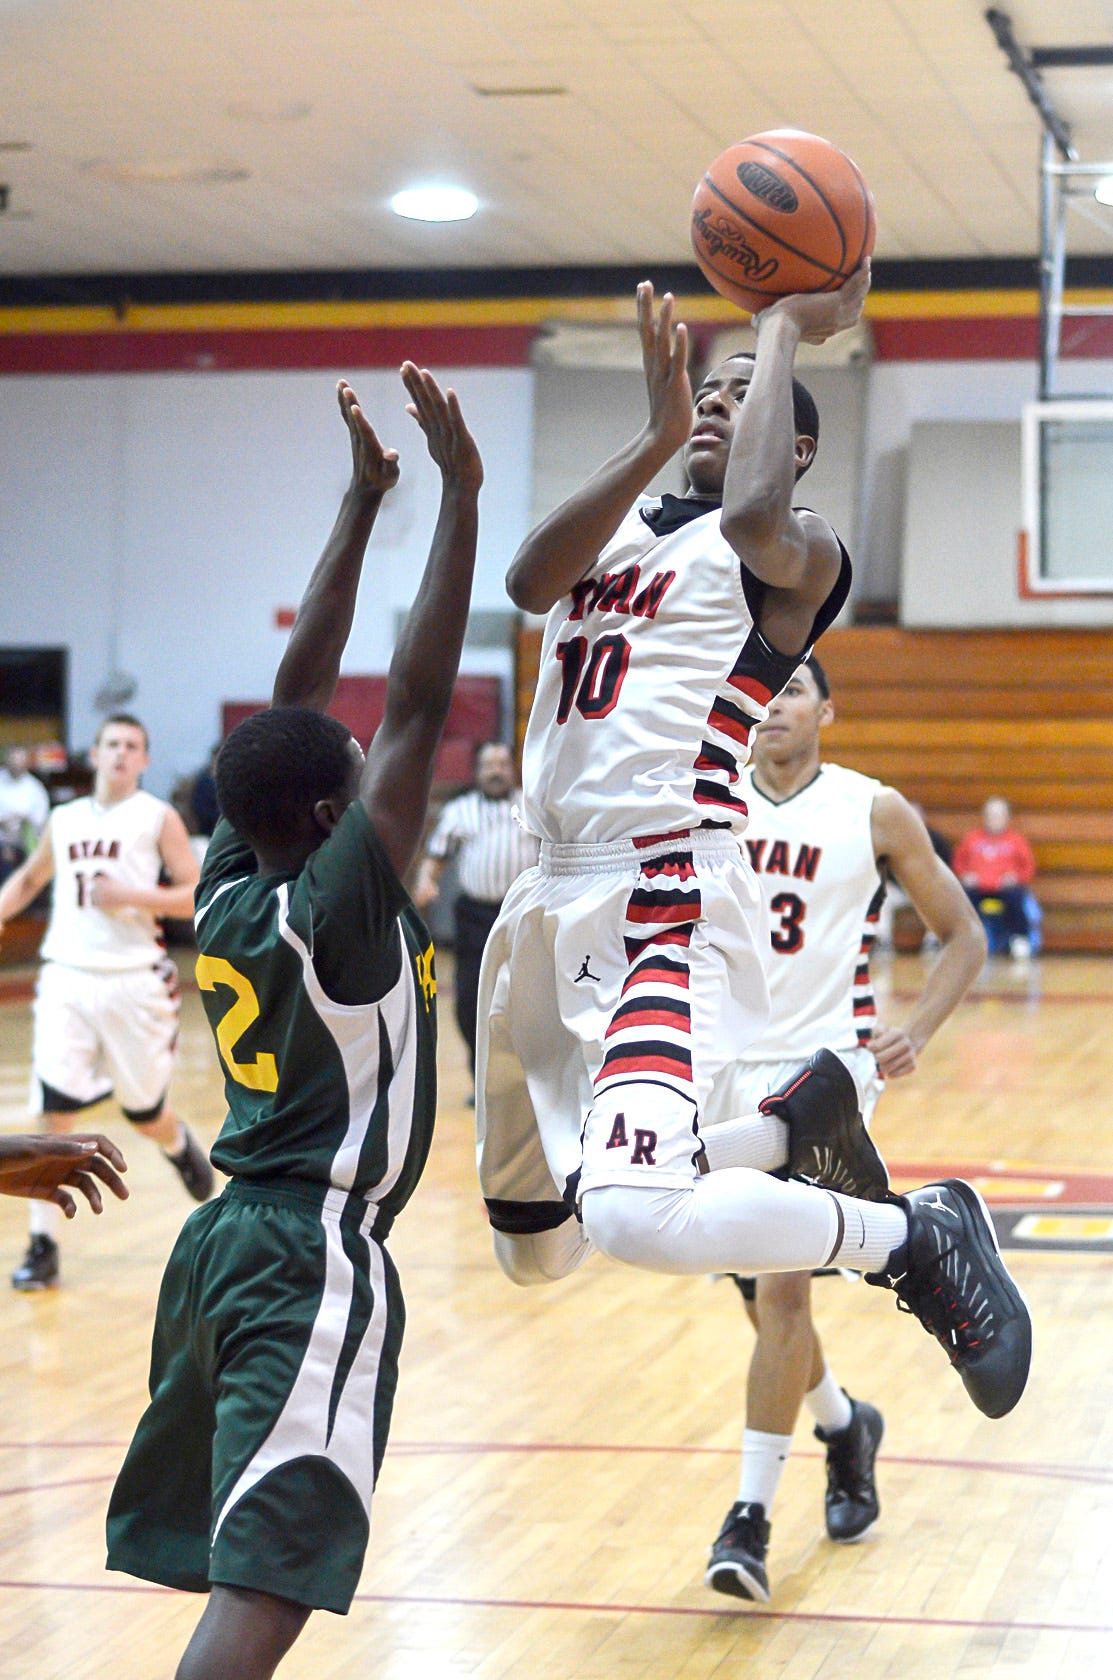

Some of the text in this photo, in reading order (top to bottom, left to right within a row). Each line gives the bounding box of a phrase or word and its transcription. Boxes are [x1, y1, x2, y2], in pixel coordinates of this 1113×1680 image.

[693, 208, 779, 281] Rawlings
[556, 633, 632, 725] 10
[736, 838, 823, 883] YAN
[770, 892, 807, 955] 3
[195, 953, 279, 1093] 2
